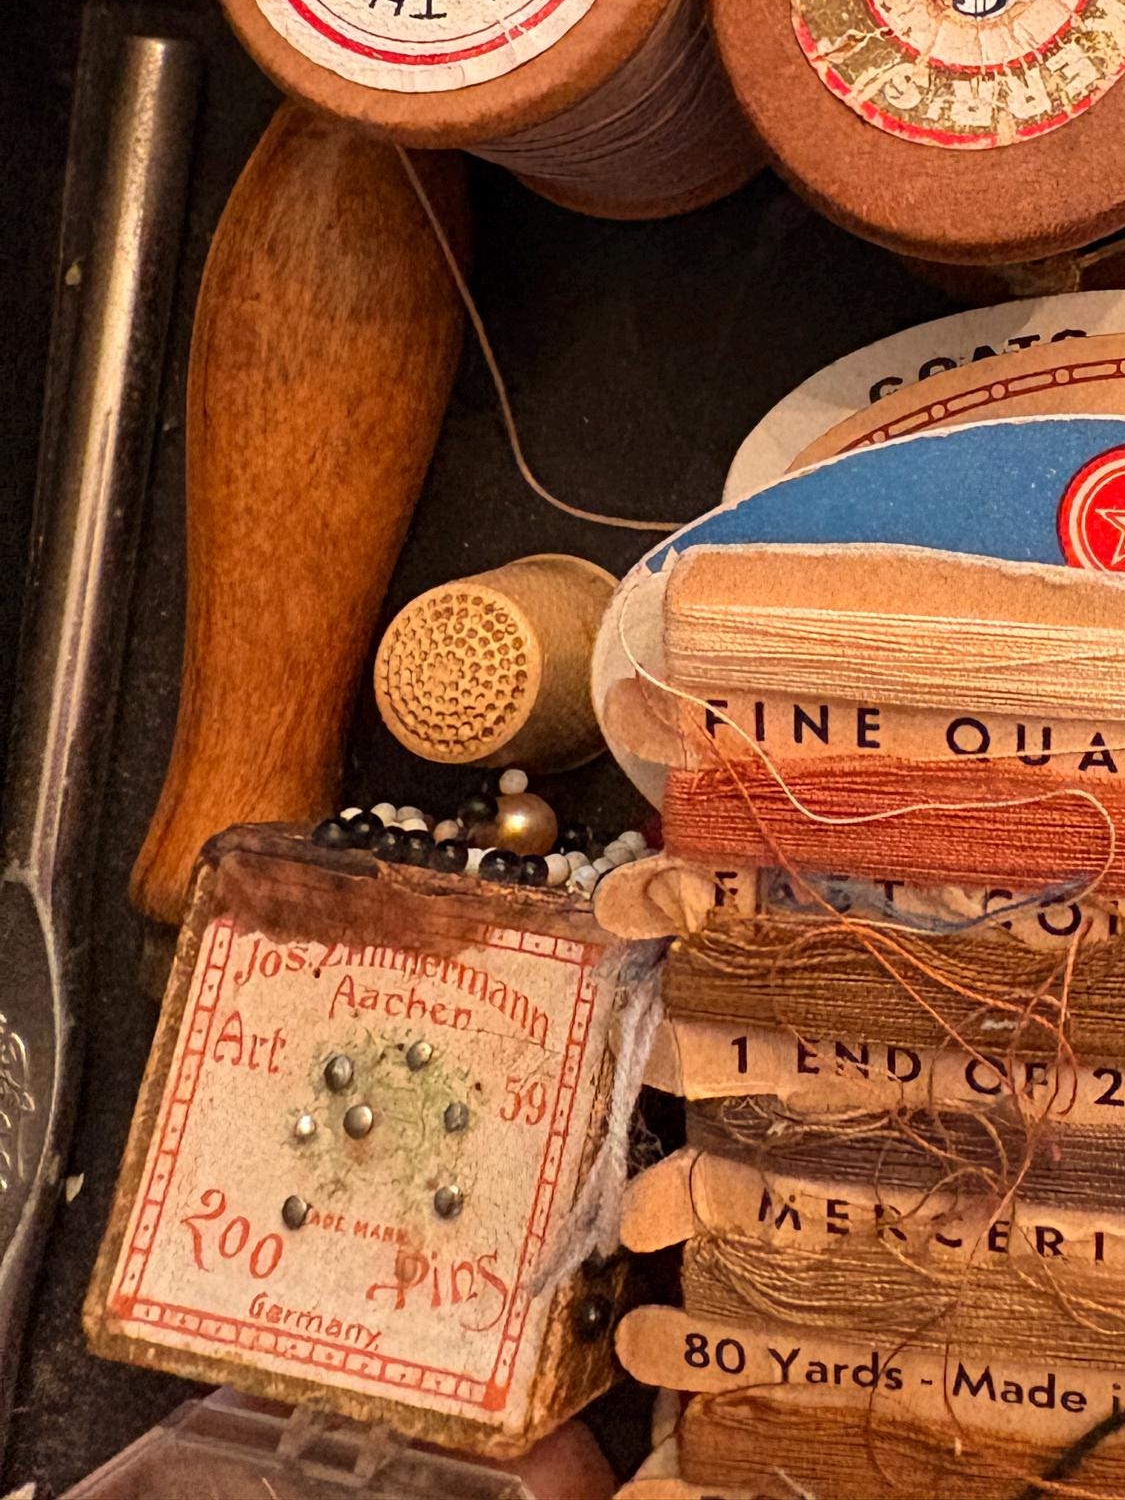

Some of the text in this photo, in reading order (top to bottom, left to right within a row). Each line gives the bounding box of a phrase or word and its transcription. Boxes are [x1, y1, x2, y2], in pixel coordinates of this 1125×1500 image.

[705, 699, 881, 748] FINE
[214, 1011, 547, 1125] Art 59
[731, 1036, 749, 1074] 1
[797, 1037, 921, 1083] END
[1092, 1068, 1125, 1107] 2
[180, 1189, 519, 1332] 200 Pins
[684, 1334, 746, 1374] 80
[952, 1363, 1088, 1413] Made
